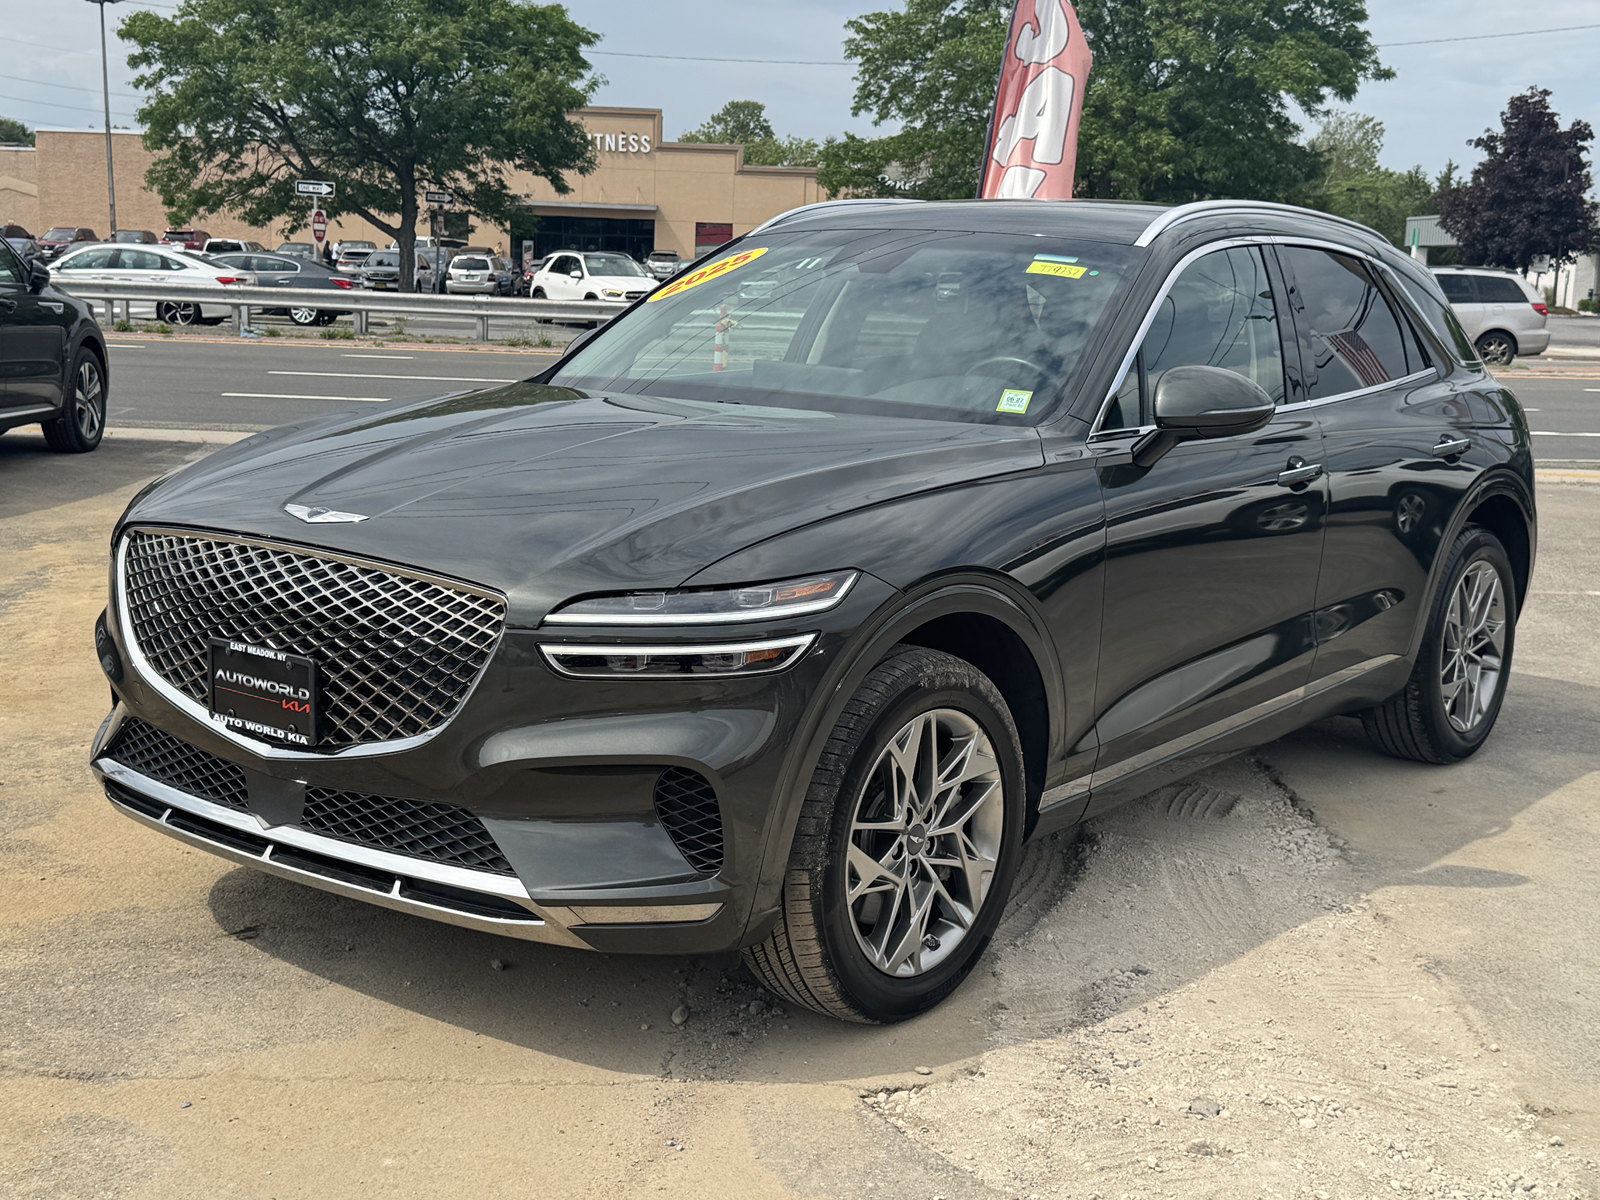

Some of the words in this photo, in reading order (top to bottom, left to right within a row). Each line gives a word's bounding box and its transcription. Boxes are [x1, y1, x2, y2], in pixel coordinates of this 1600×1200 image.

[587, 132, 651, 154] ITNESS
[661, 251, 754, 298] 2025
[230, 642, 246, 653] EAST
[277, 652, 287, 662] NY
[215, 669, 310, 700] AUTOWORLD
[282, 699, 311, 714] KIA
[213, 713, 243, 728] AUTO
[245, 721, 285, 739] WORLD
[287, 732, 308, 745] KIA
